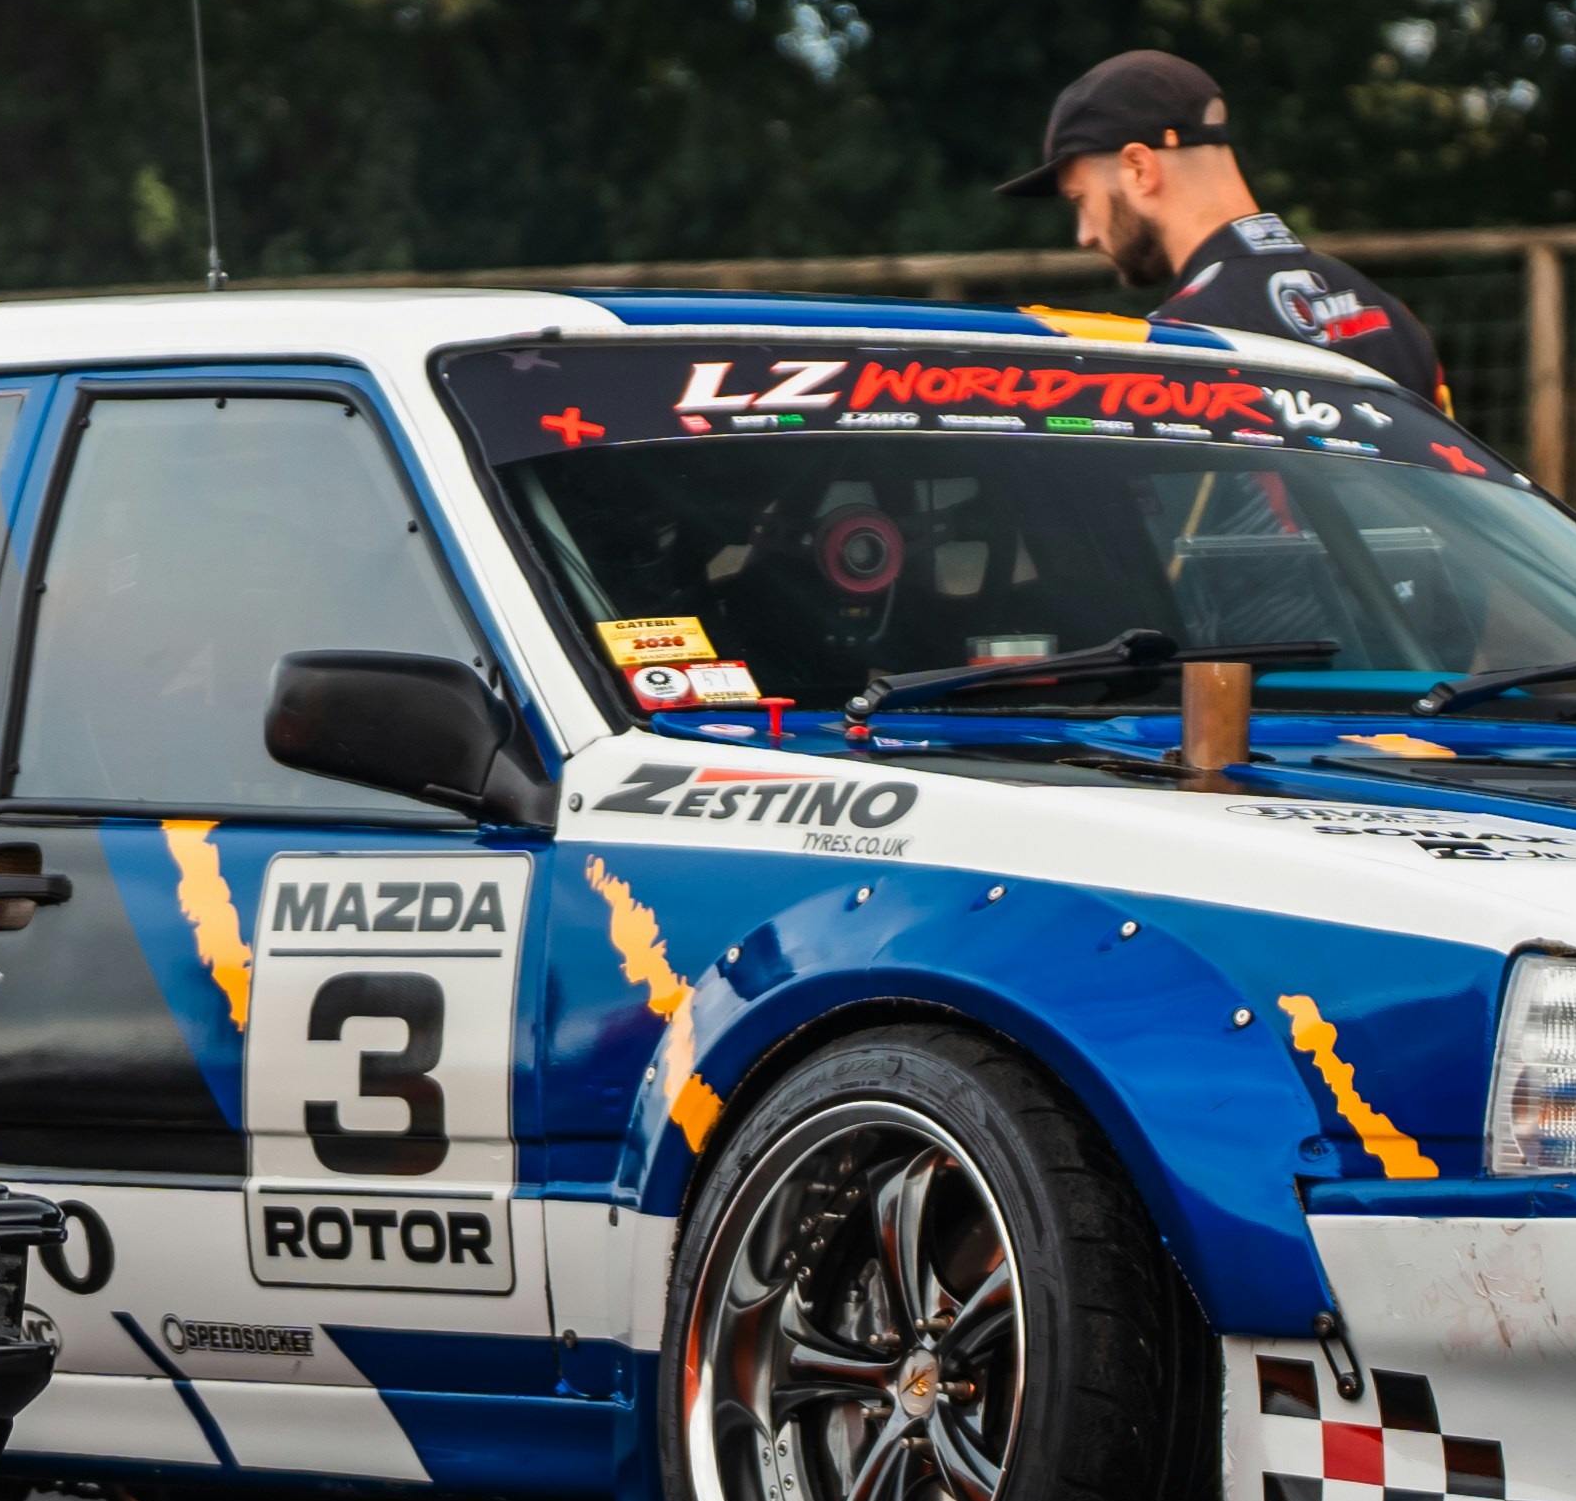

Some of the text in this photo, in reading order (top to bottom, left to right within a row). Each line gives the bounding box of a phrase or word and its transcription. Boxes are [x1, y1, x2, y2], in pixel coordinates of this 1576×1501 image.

[672, 360, 848, 411] LZ
[850, 361, 1087, 411] WORLD
[1078, 371, 1274, 426] TOUR
[615, 619, 678, 630] GATEBIL
[592, 763, 919, 829] ZESTINO
[802, 833, 910, 857] TYRES.CO.UK
[1312, 824, 1576, 846] SONAX
[271, 881, 506, 932] MAZDA
[304, 971, 450, 1176] 3
[263, 1205, 494, 1265] ROTOR
[184, 1319, 315, 1356] SPEEDSOCKET
